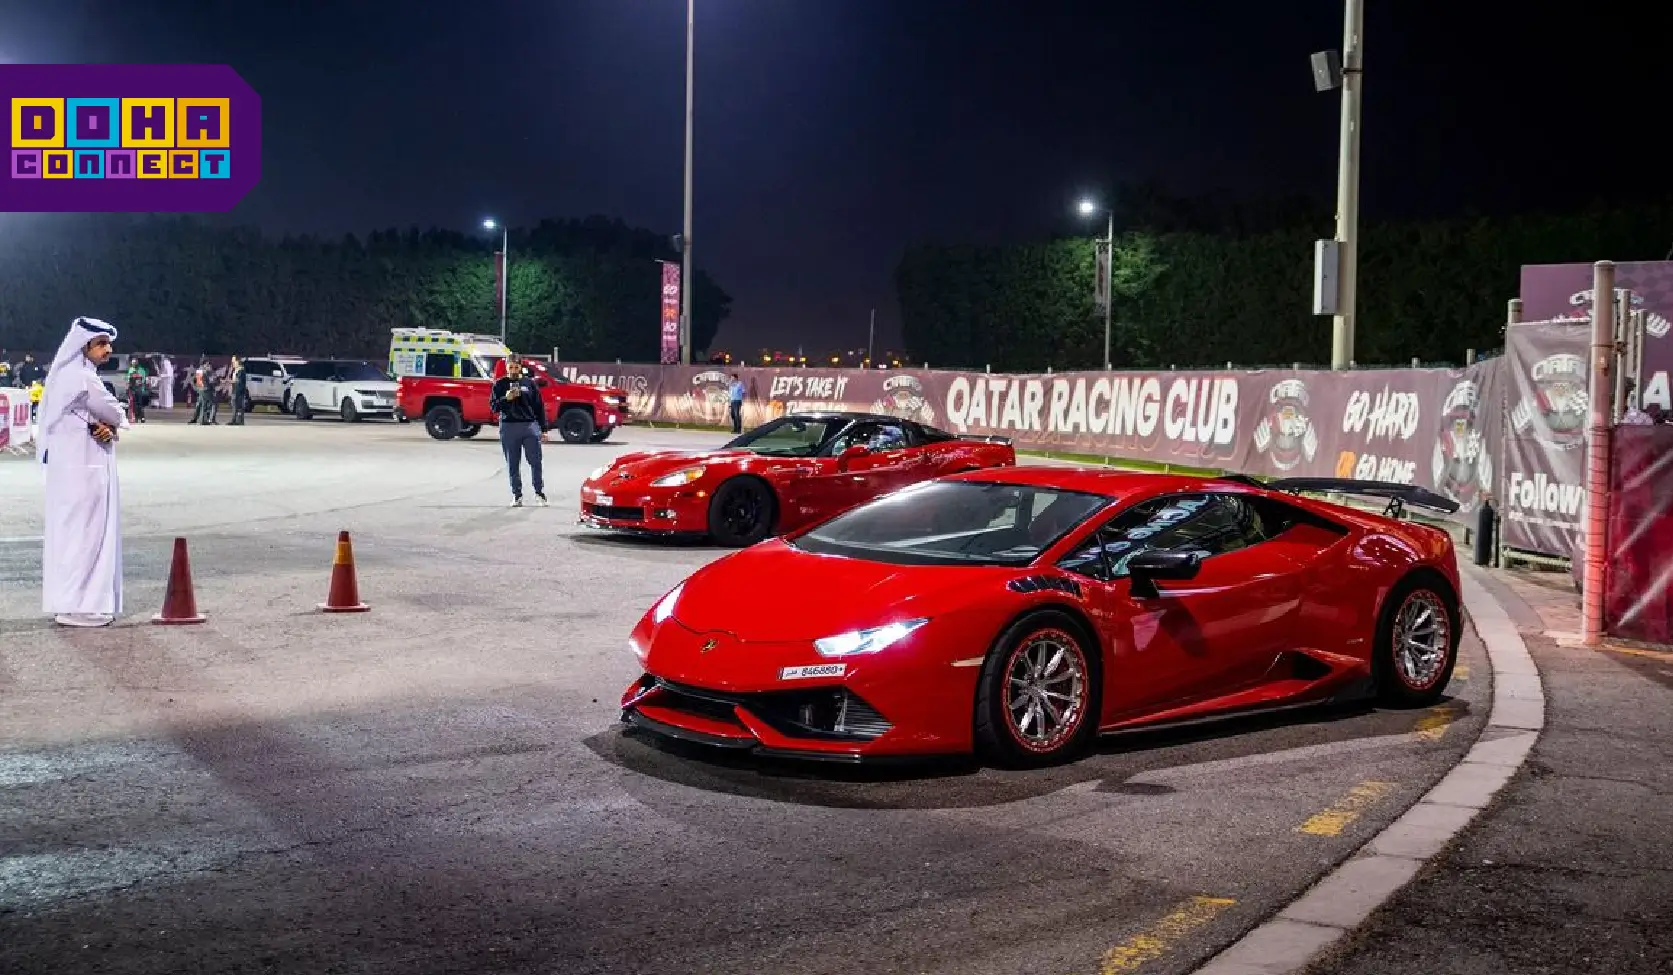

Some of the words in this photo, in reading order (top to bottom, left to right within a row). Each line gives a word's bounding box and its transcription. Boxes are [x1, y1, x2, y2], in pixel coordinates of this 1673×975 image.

[770, 376, 803, 398] LET'S
[805, 376, 834, 397] TAKE
[834, 374, 849, 400] IT
[946, 376, 1044, 432] QATAR
[1048, 377, 1160, 437] RACING
[1163, 378, 1239, 444] CLUB
[1509, 472, 1584, 516] Follow
